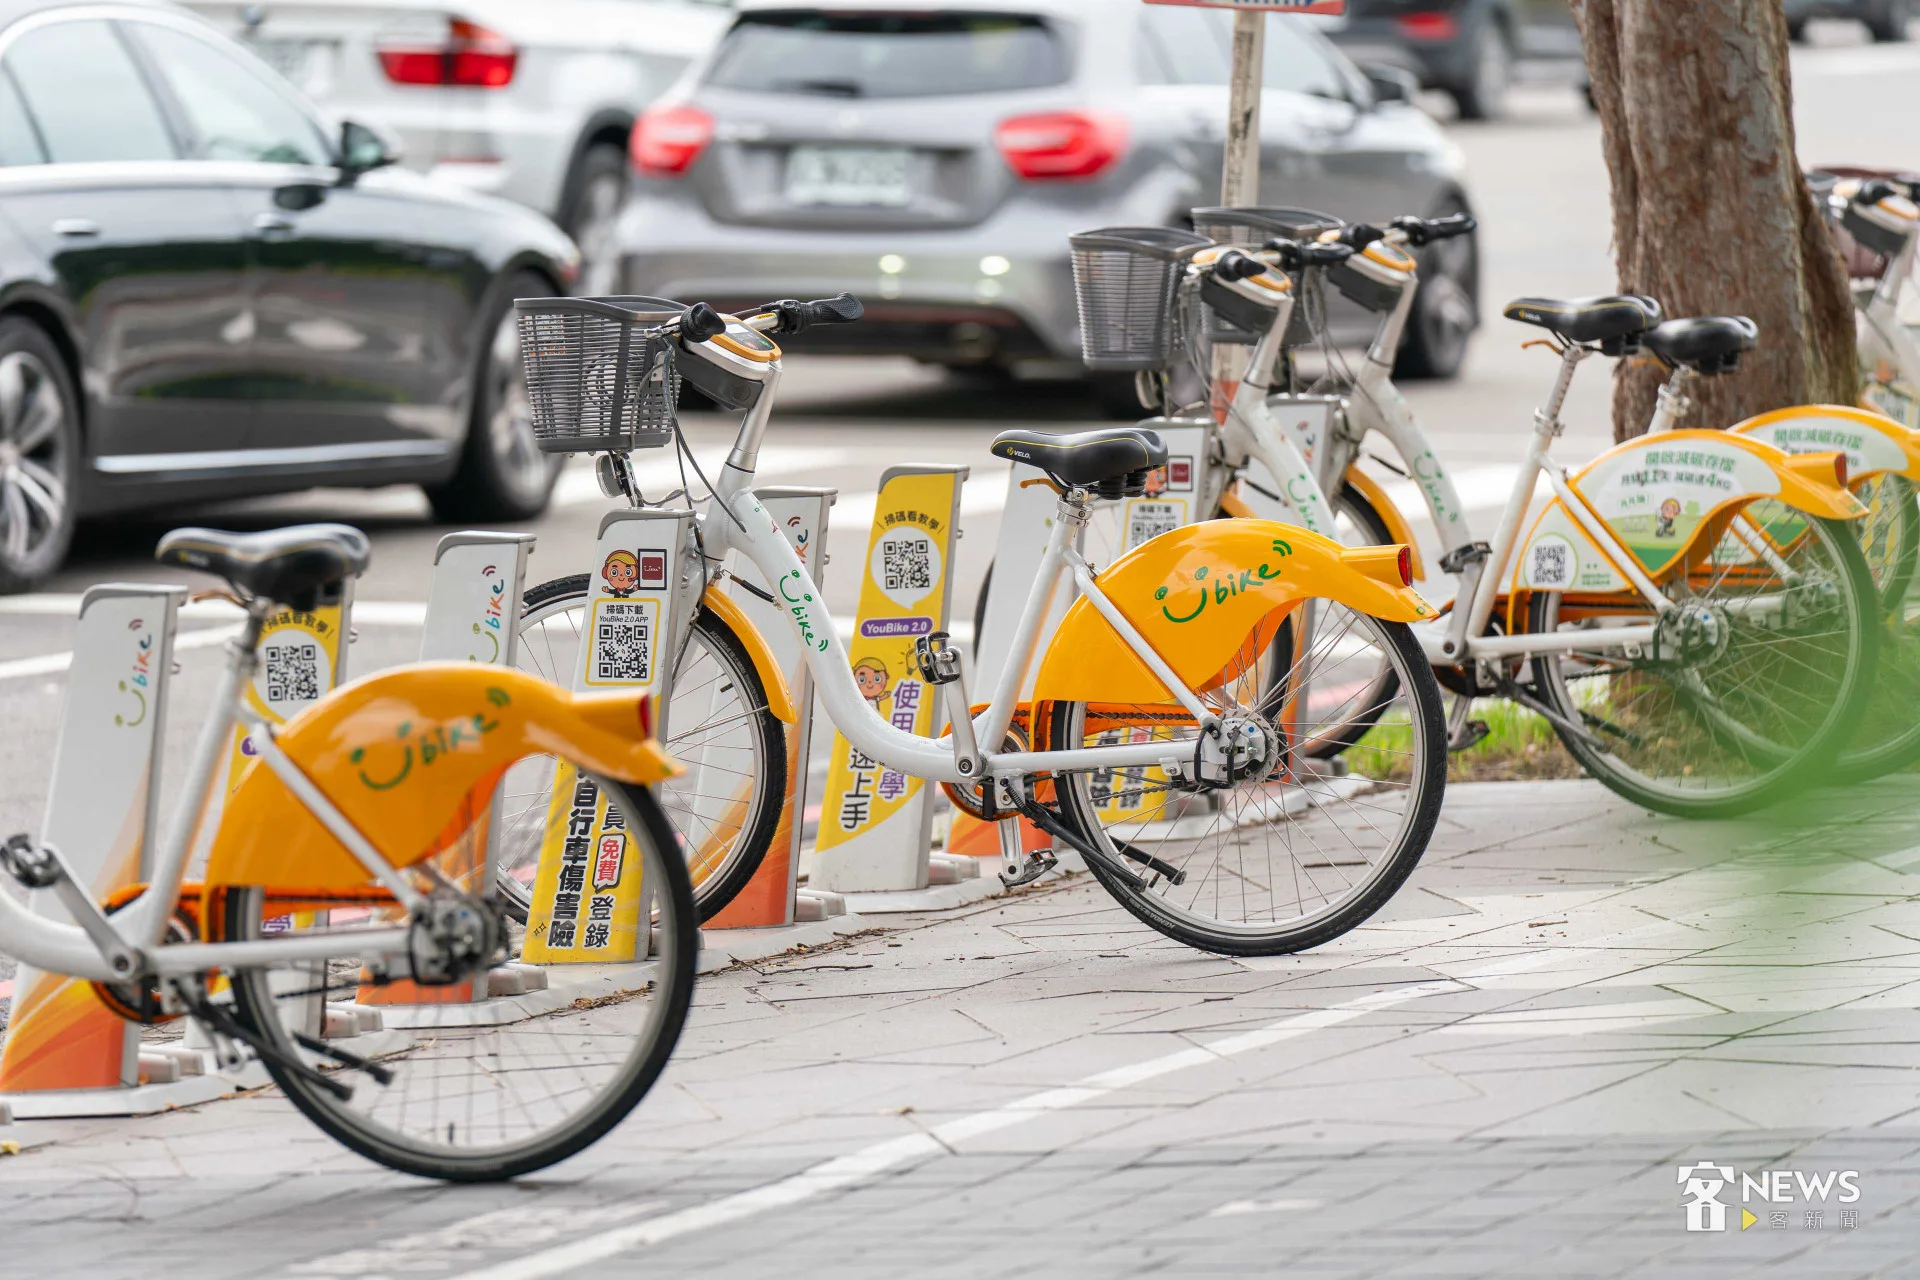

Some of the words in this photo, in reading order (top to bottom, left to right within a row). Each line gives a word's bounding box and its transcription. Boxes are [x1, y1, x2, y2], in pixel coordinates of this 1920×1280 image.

[1013, 450, 1031, 459] VELO
[884, 511, 940, 531] 掃碼看教學
[606, 605, 644, 614] 掃碼下載
[866, 624, 909, 633] YouBike
[911, 622, 928, 631] 2.0
[548, 768, 599, 947] 自行車傷害險
[597, 839, 619, 881] 免費
[584, 895, 613, 947] 登錄
